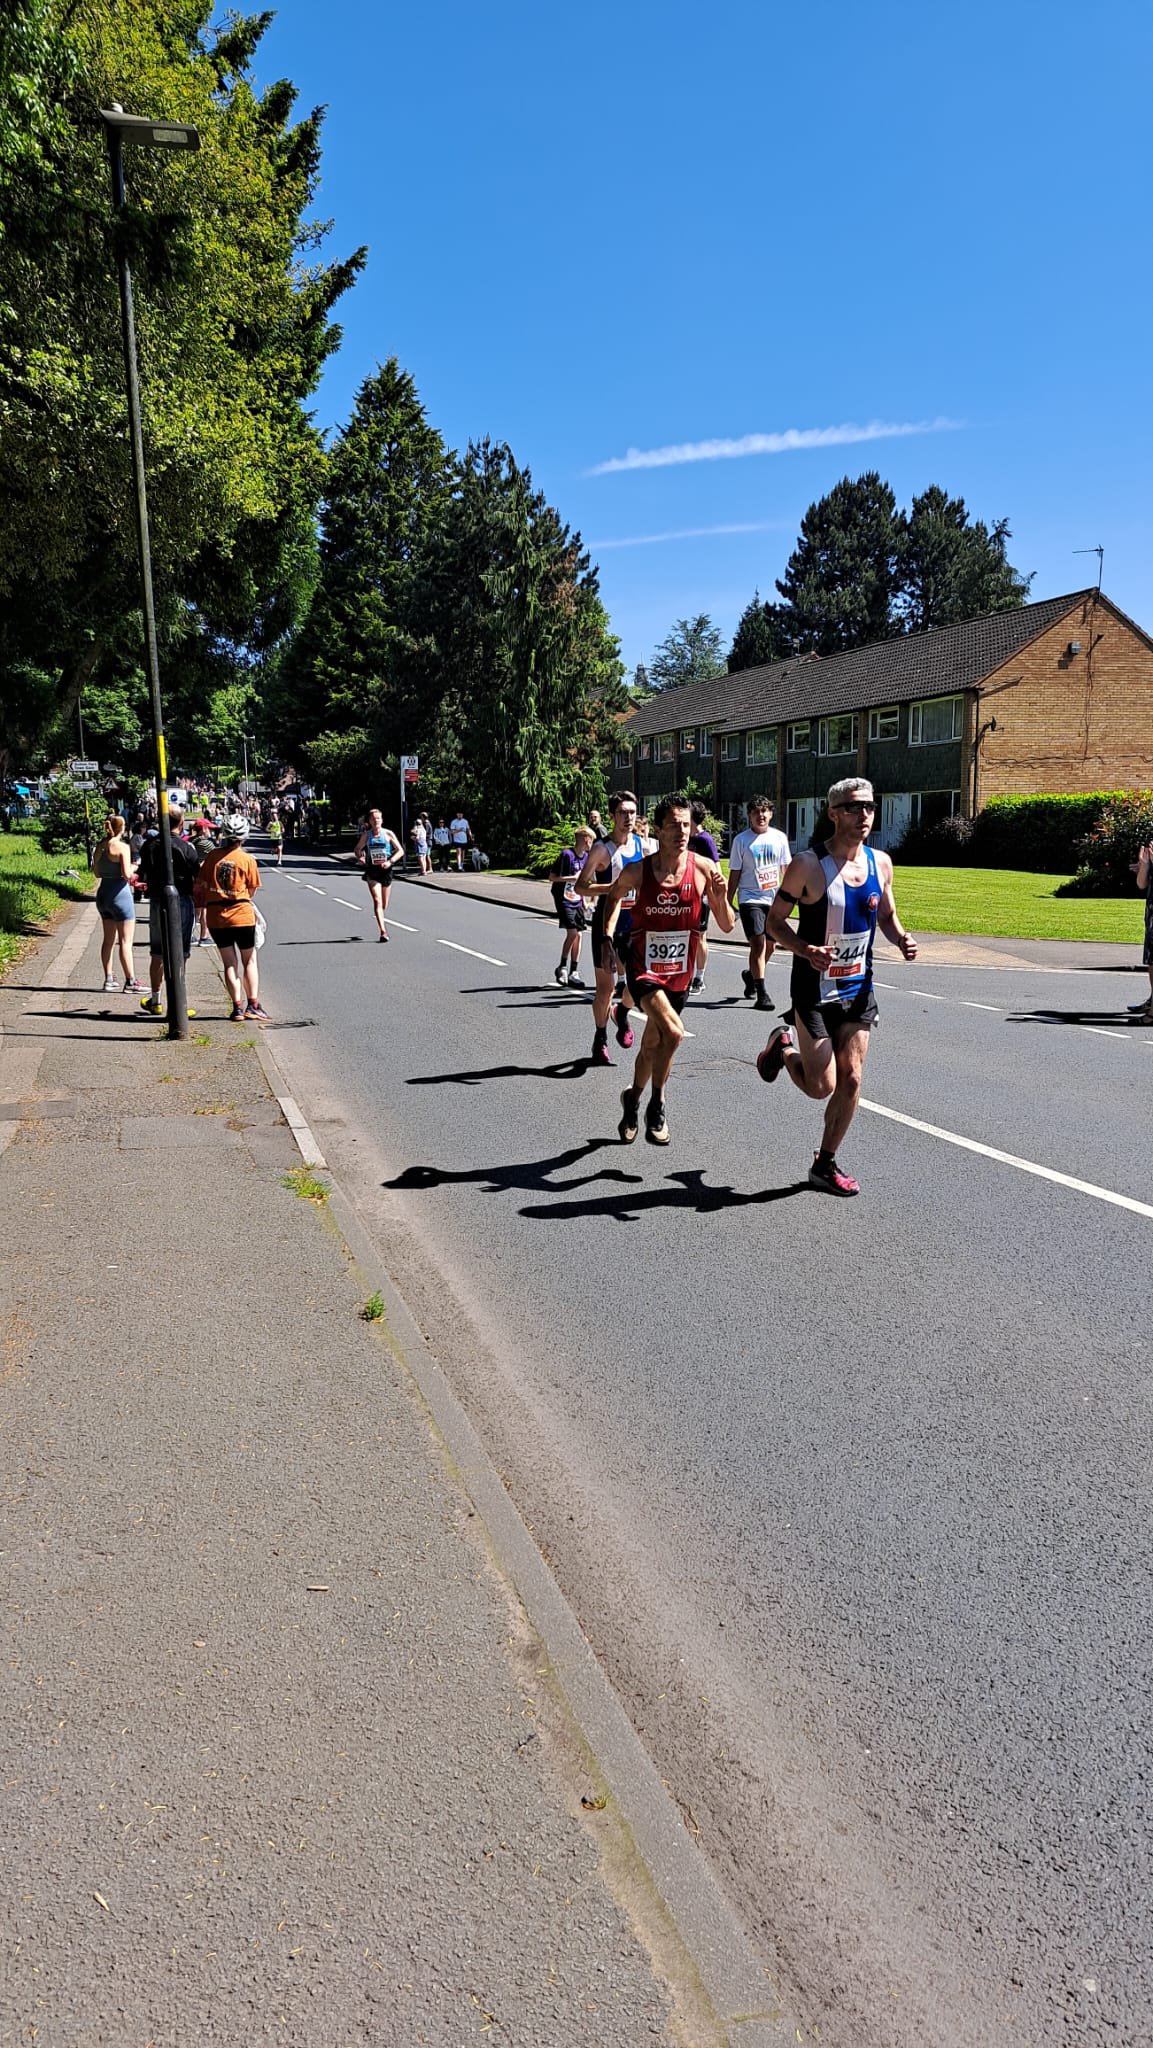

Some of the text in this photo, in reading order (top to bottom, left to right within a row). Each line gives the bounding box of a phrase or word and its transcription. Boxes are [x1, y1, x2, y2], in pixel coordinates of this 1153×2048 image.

[758, 870, 778, 883] 5075
[645, 905, 691, 916] goodgym
[648, 943, 686, 959] 3922
